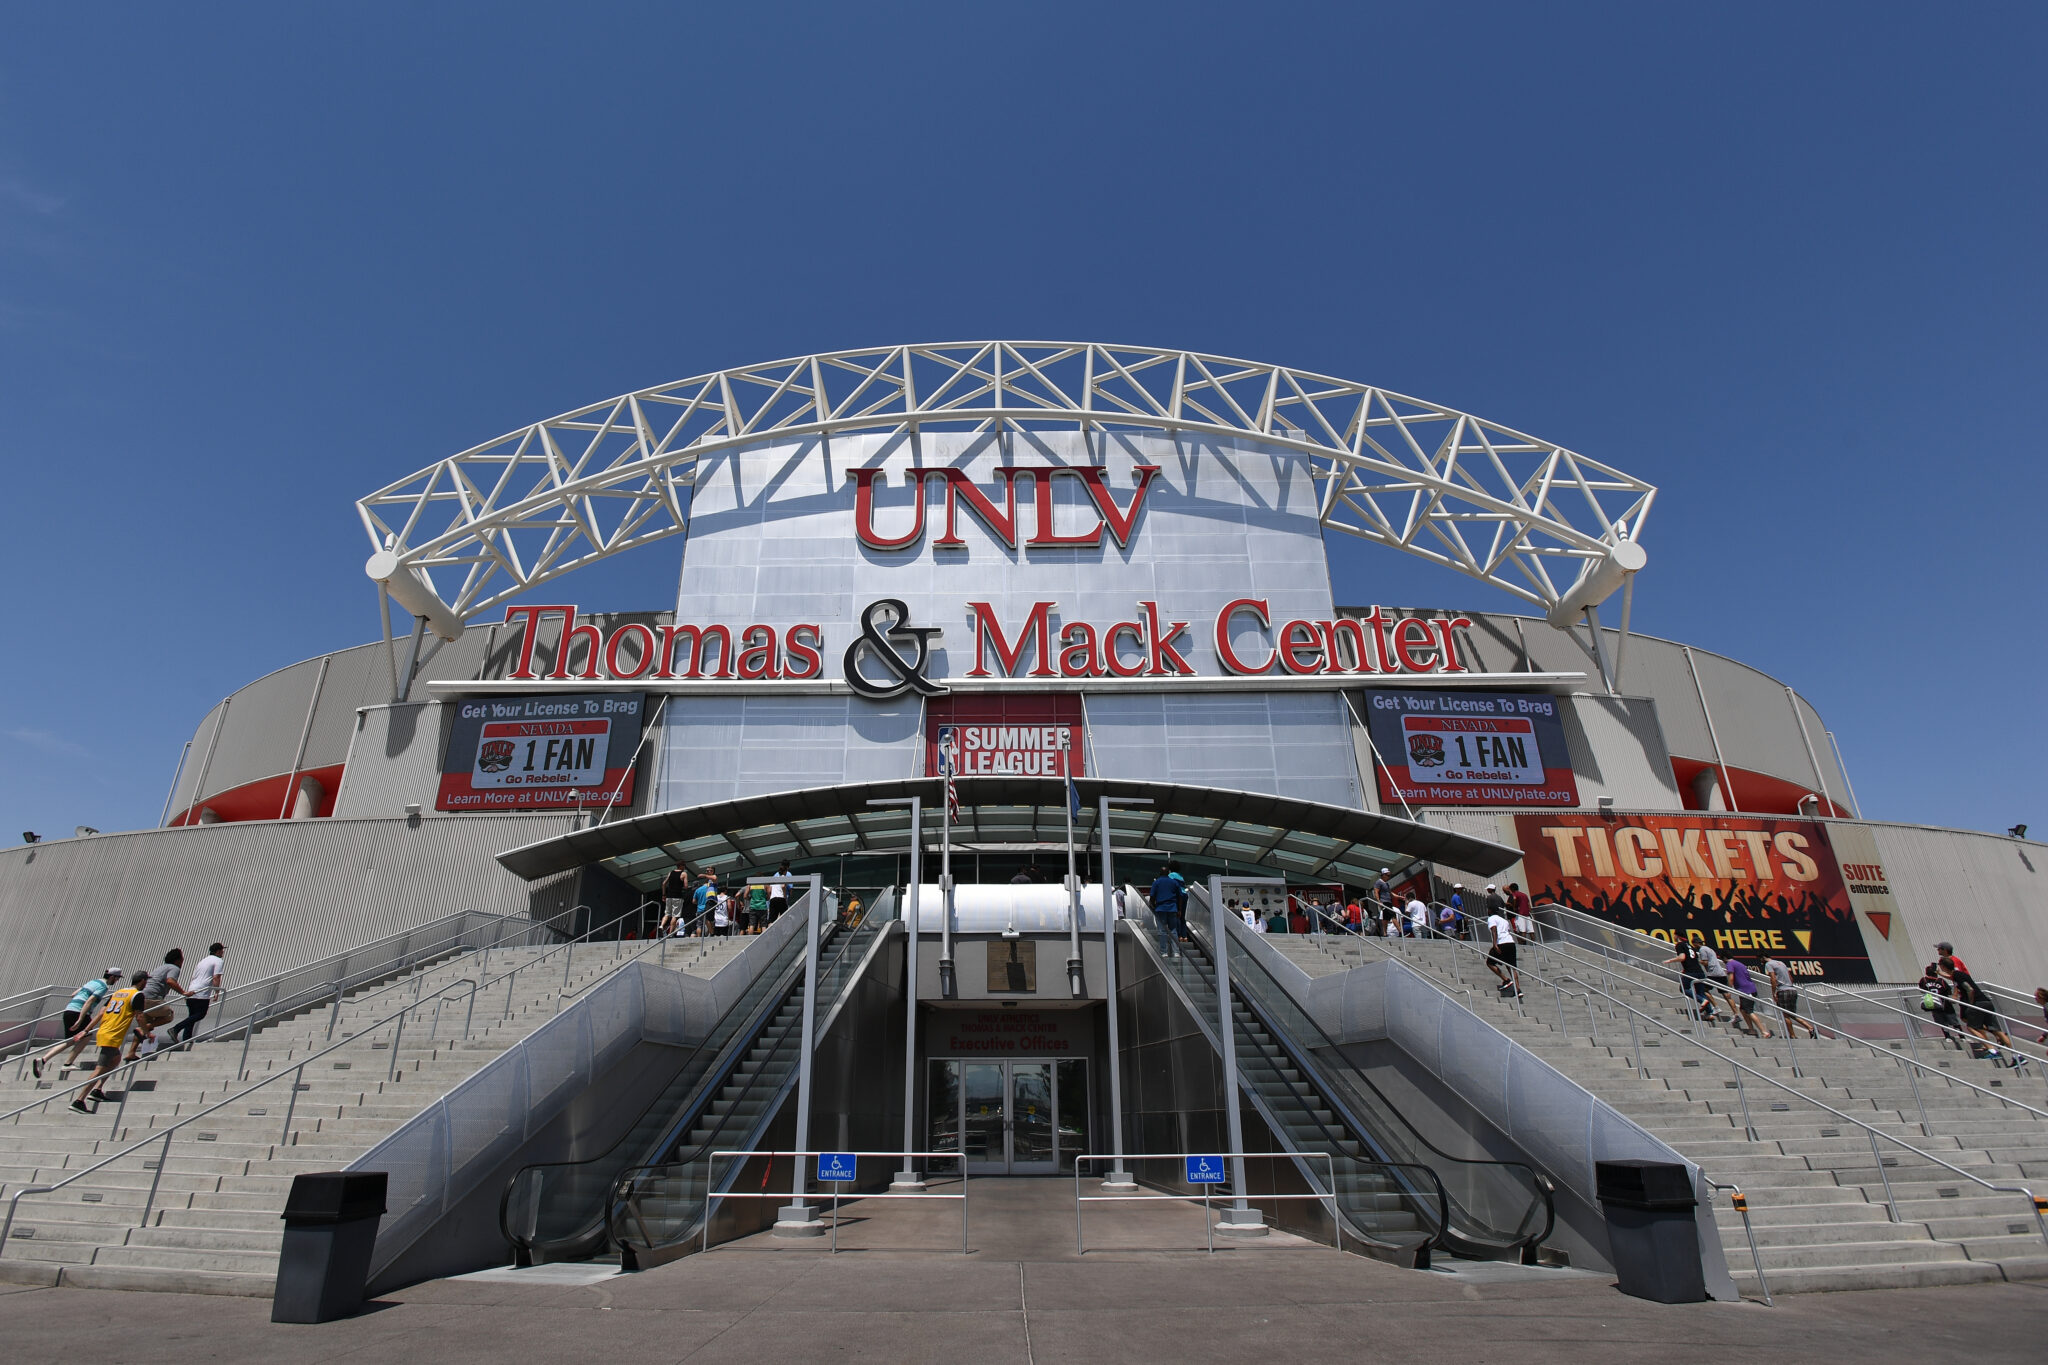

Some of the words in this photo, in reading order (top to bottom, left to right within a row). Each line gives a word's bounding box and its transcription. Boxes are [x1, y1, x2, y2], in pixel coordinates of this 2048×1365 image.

[846, 465, 1162, 550] UNLV
[503, 604, 823, 681] Thomas
[844, 598, 951, 698] &
[963, 599, 1198, 677] Mack
[1213, 598, 1474, 676] Center
[462, 704, 487, 719] Get
[491, 703, 521, 718] Your
[524, 701, 578, 716] License
[583, 700, 599, 714] To
[603, 699, 638, 715] Brag
[1373, 696, 1400, 710] Get
[1403, 696, 1435, 711] Your
[1439, 697, 1495, 712] License
[1498, 699, 1515, 713] To
[1518, 699, 1553, 716] Brag
[519, 723, 574, 736] NEVADA
[1441, 719, 1499, 732] NEVADA
[964, 727, 1071, 750] SUMMER
[523, 739, 537, 771] 1
[543, 738, 595, 771] FAN
[1455, 736, 1472, 767] 1
[1475, 736, 1528, 769] FAN
[964, 751, 1056, 775] LEAGUE
[505, 774, 522, 784] Go
[525, 774, 571, 784] Rebels!
[1445, 770, 1463, 780] Go
[1466, 770, 1512, 781] Rebels!
[447, 793, 480, 805] Learn
[485, 792, 515, 804] More
[518, 792, 530, 803] at
[1391, 787, 1427, 799] Learn
[1430, 787, 1462, 799] More
[1465, 788, 1479, 800] at
[1481, 788, 1571, 802] UNLVplate.org
[1540, 826, 1819, 882] TICKETS
[1842, 863, 1886, 882] SUITE
[1849, 884, 1890, 895] entrance
[1713, 929, 1787, 950] HERE
[106, 1000, 124, 1013] 32
[950, 1036, 1016, 1051] Executive
[1019, 1036, 1069, 1051] Offices
[821, 1170, 852, 1178] ENTRANCE
[1190, 1172, 1221, 1180] ENTRANCE
